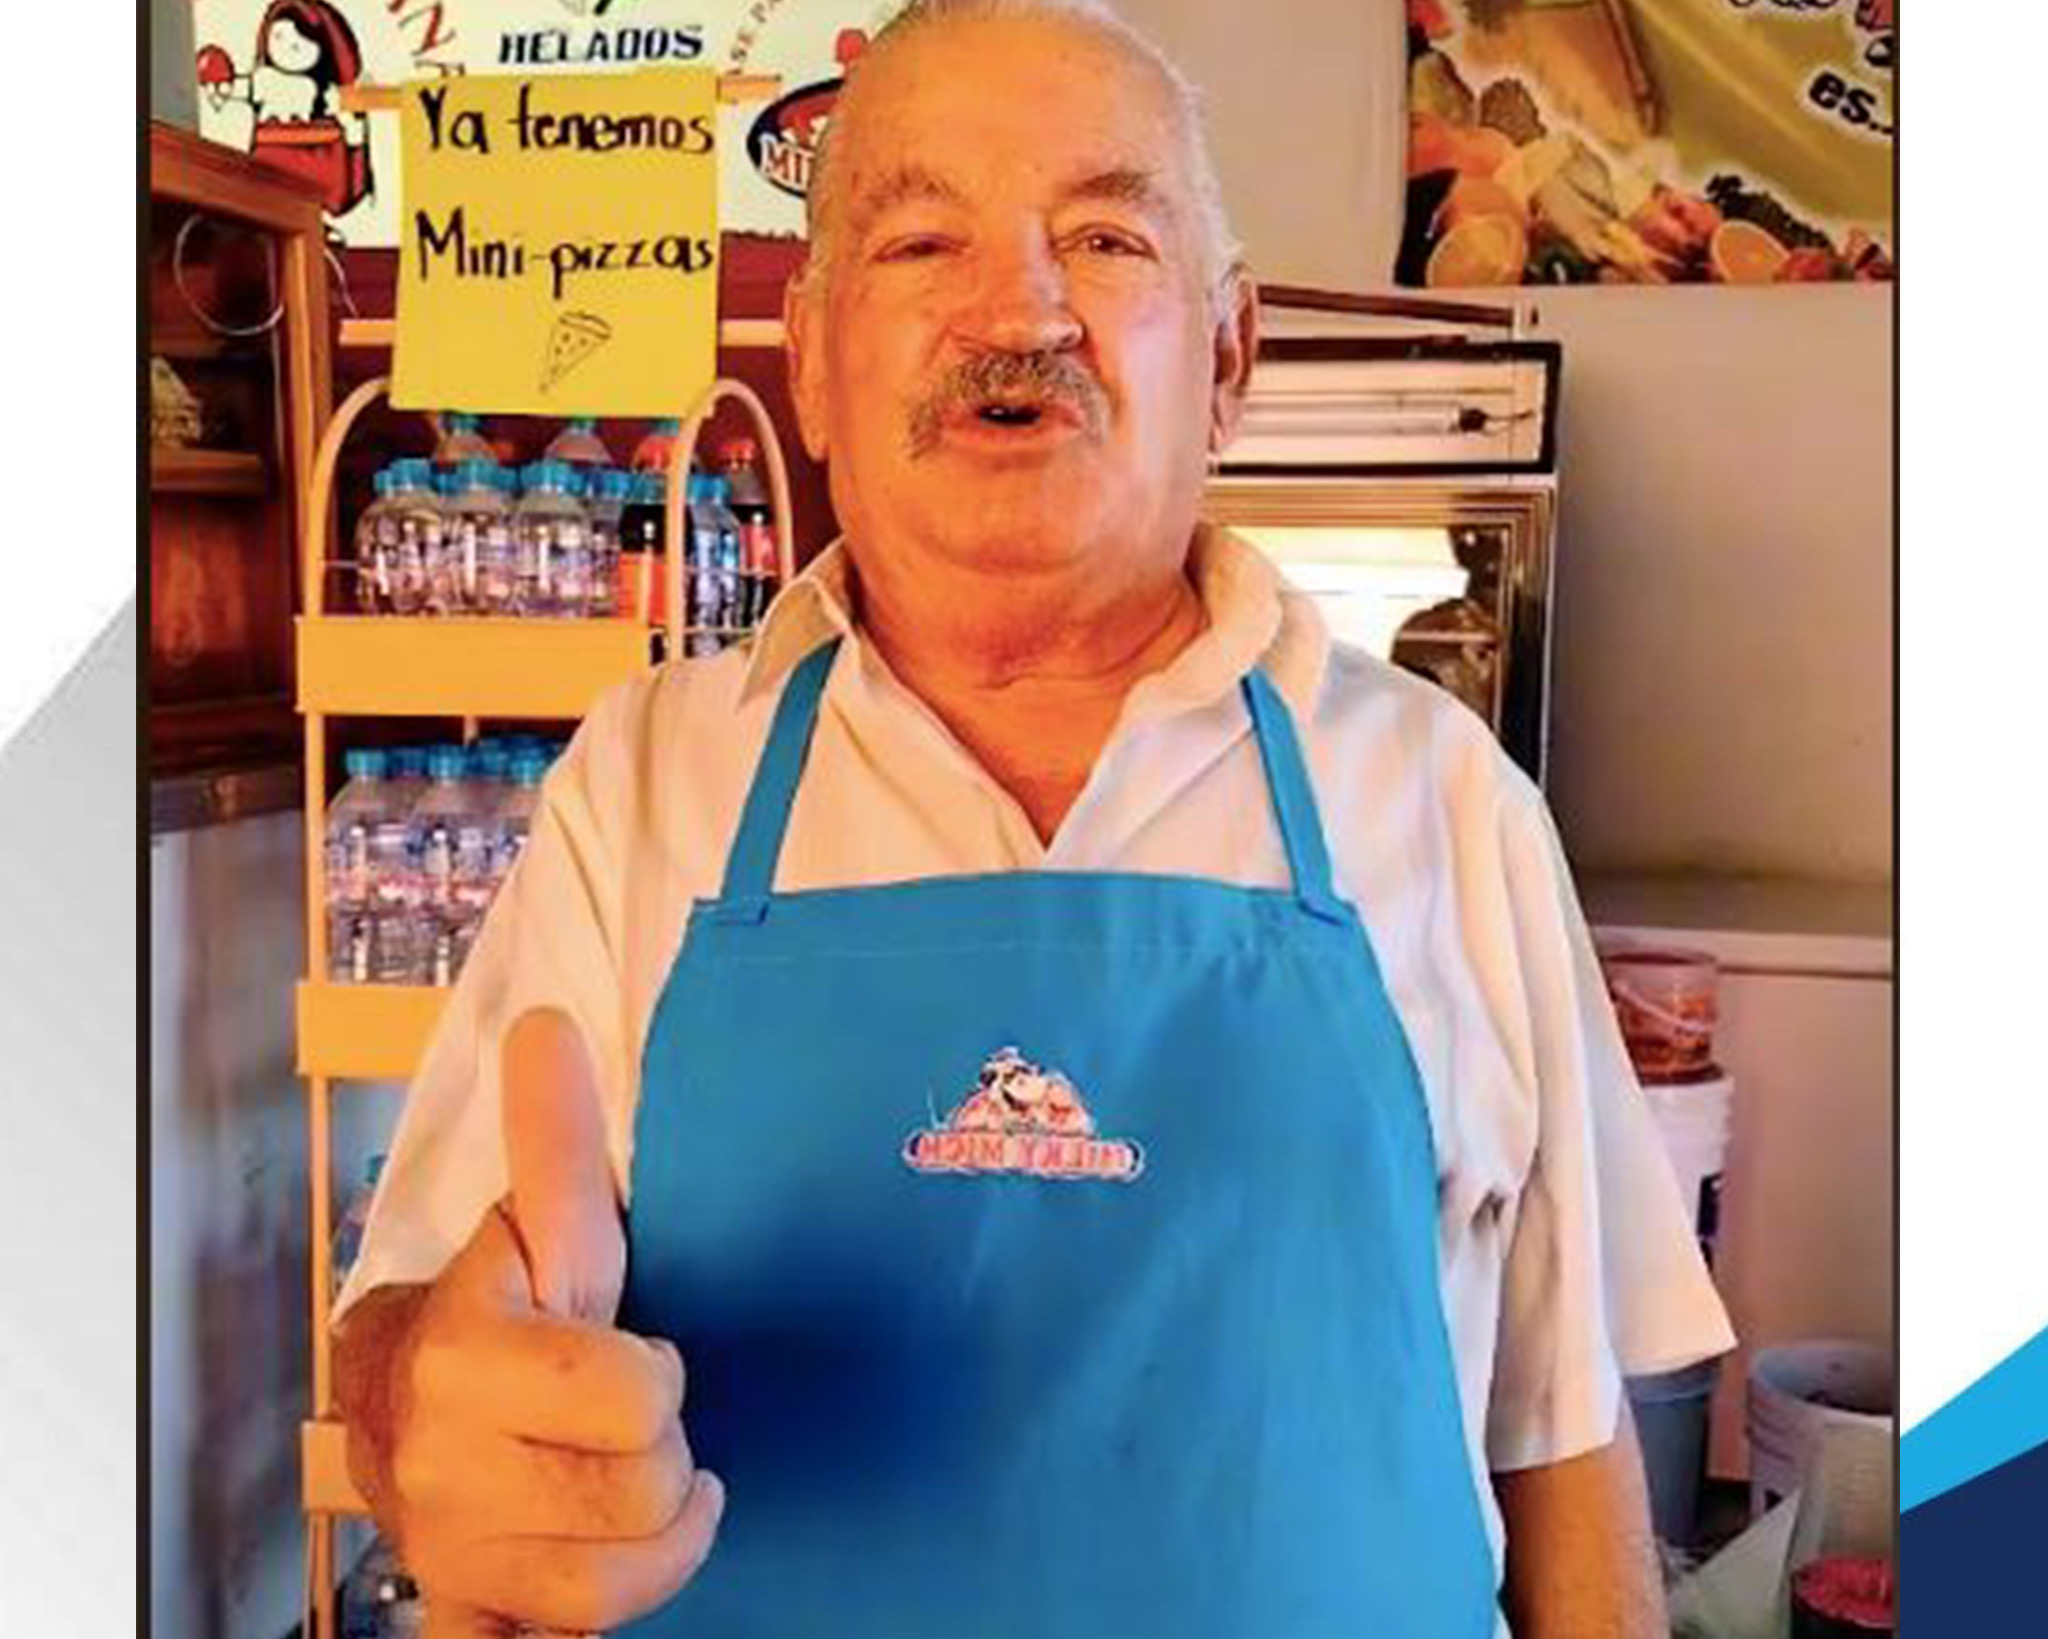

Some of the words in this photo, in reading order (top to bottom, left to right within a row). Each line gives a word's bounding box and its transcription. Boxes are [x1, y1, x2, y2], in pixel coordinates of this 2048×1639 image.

[498, 25, 703, 63] HELADOS
[419, 85, 489, 154] Ya
[507, 83, 714, 154] tenemos
[415, 206, 714, 300] Mini-pizzas
